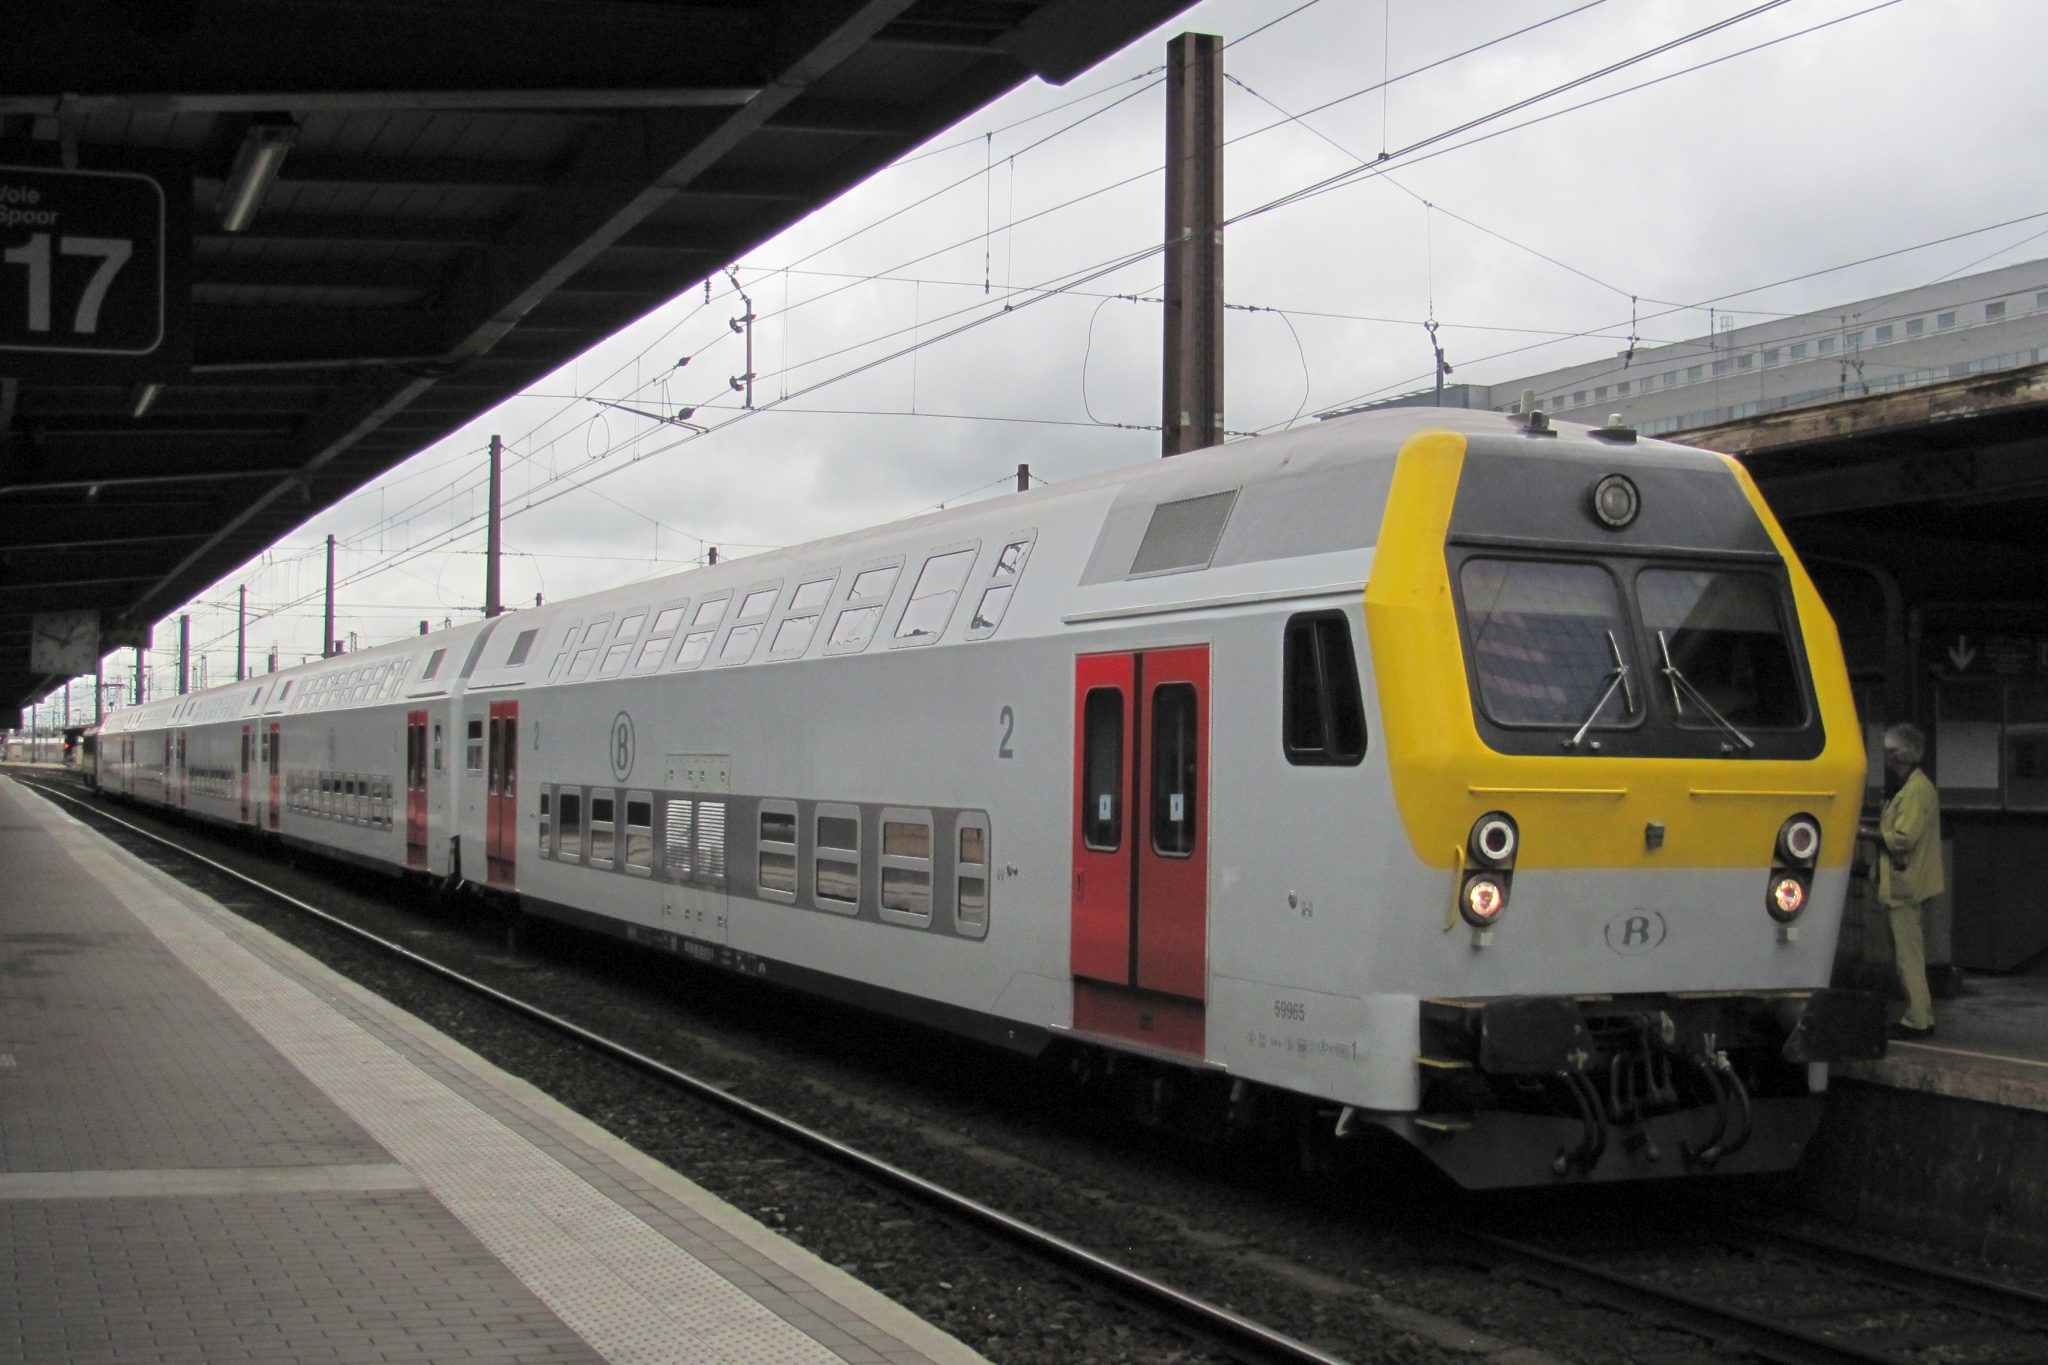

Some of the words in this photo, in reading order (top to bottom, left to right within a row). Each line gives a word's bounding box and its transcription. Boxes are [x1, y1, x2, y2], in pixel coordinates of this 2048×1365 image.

[5, 233, 132, 333] 17
[999, 704, 1015, 759] 2
[1273, 1000, 1306, 1022] 59965
